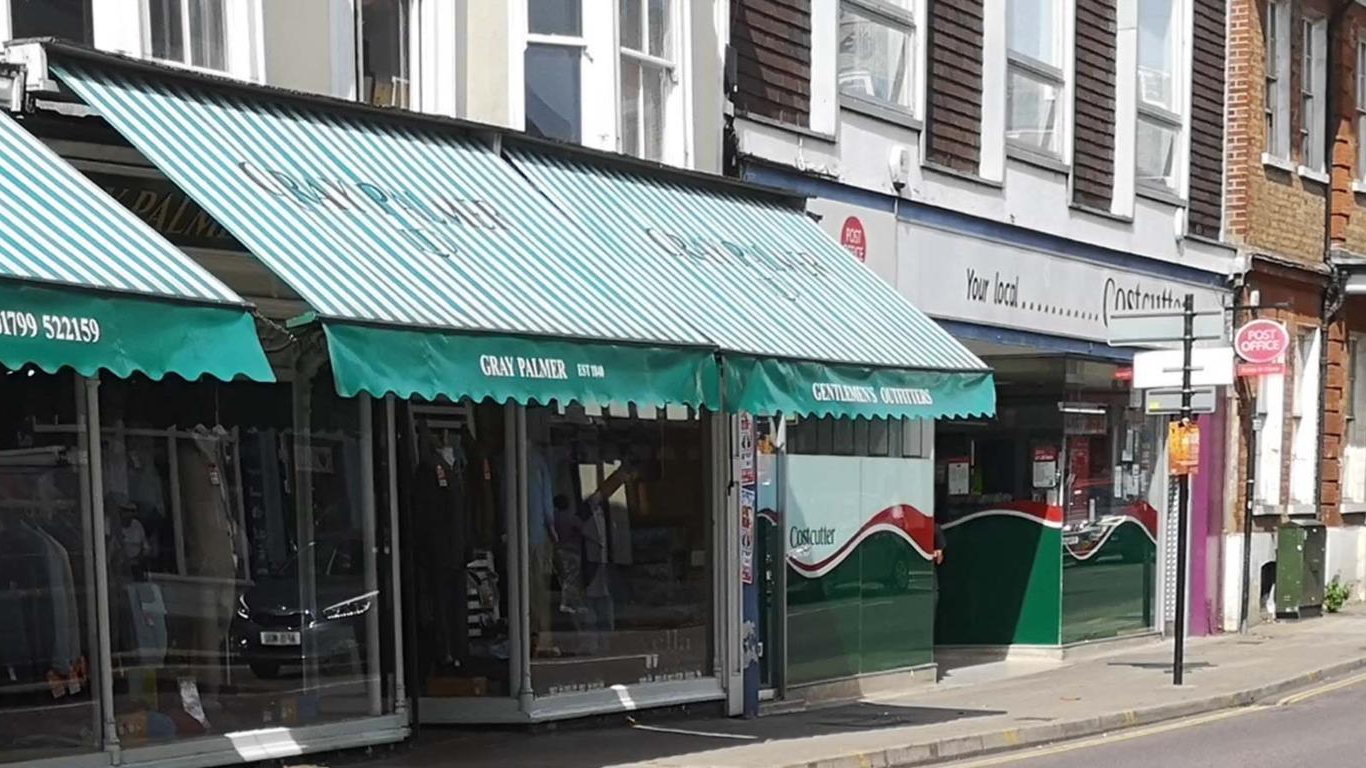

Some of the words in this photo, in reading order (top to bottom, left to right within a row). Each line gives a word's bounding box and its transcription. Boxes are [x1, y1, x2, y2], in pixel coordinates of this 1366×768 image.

[966, 267, 989, 301] Your
[42, 313, 100, 344] 522159
[1248, 329, 1278, 341] POST
[1241, 340, 1280, 352] OFFICE
[480, 354, 515, 377] GRAY
[516, 356, 569, 380] PALMER
[880, 386, 933, 405] OUTFITTERS
[790, 526, 835, 548] Costcutter
